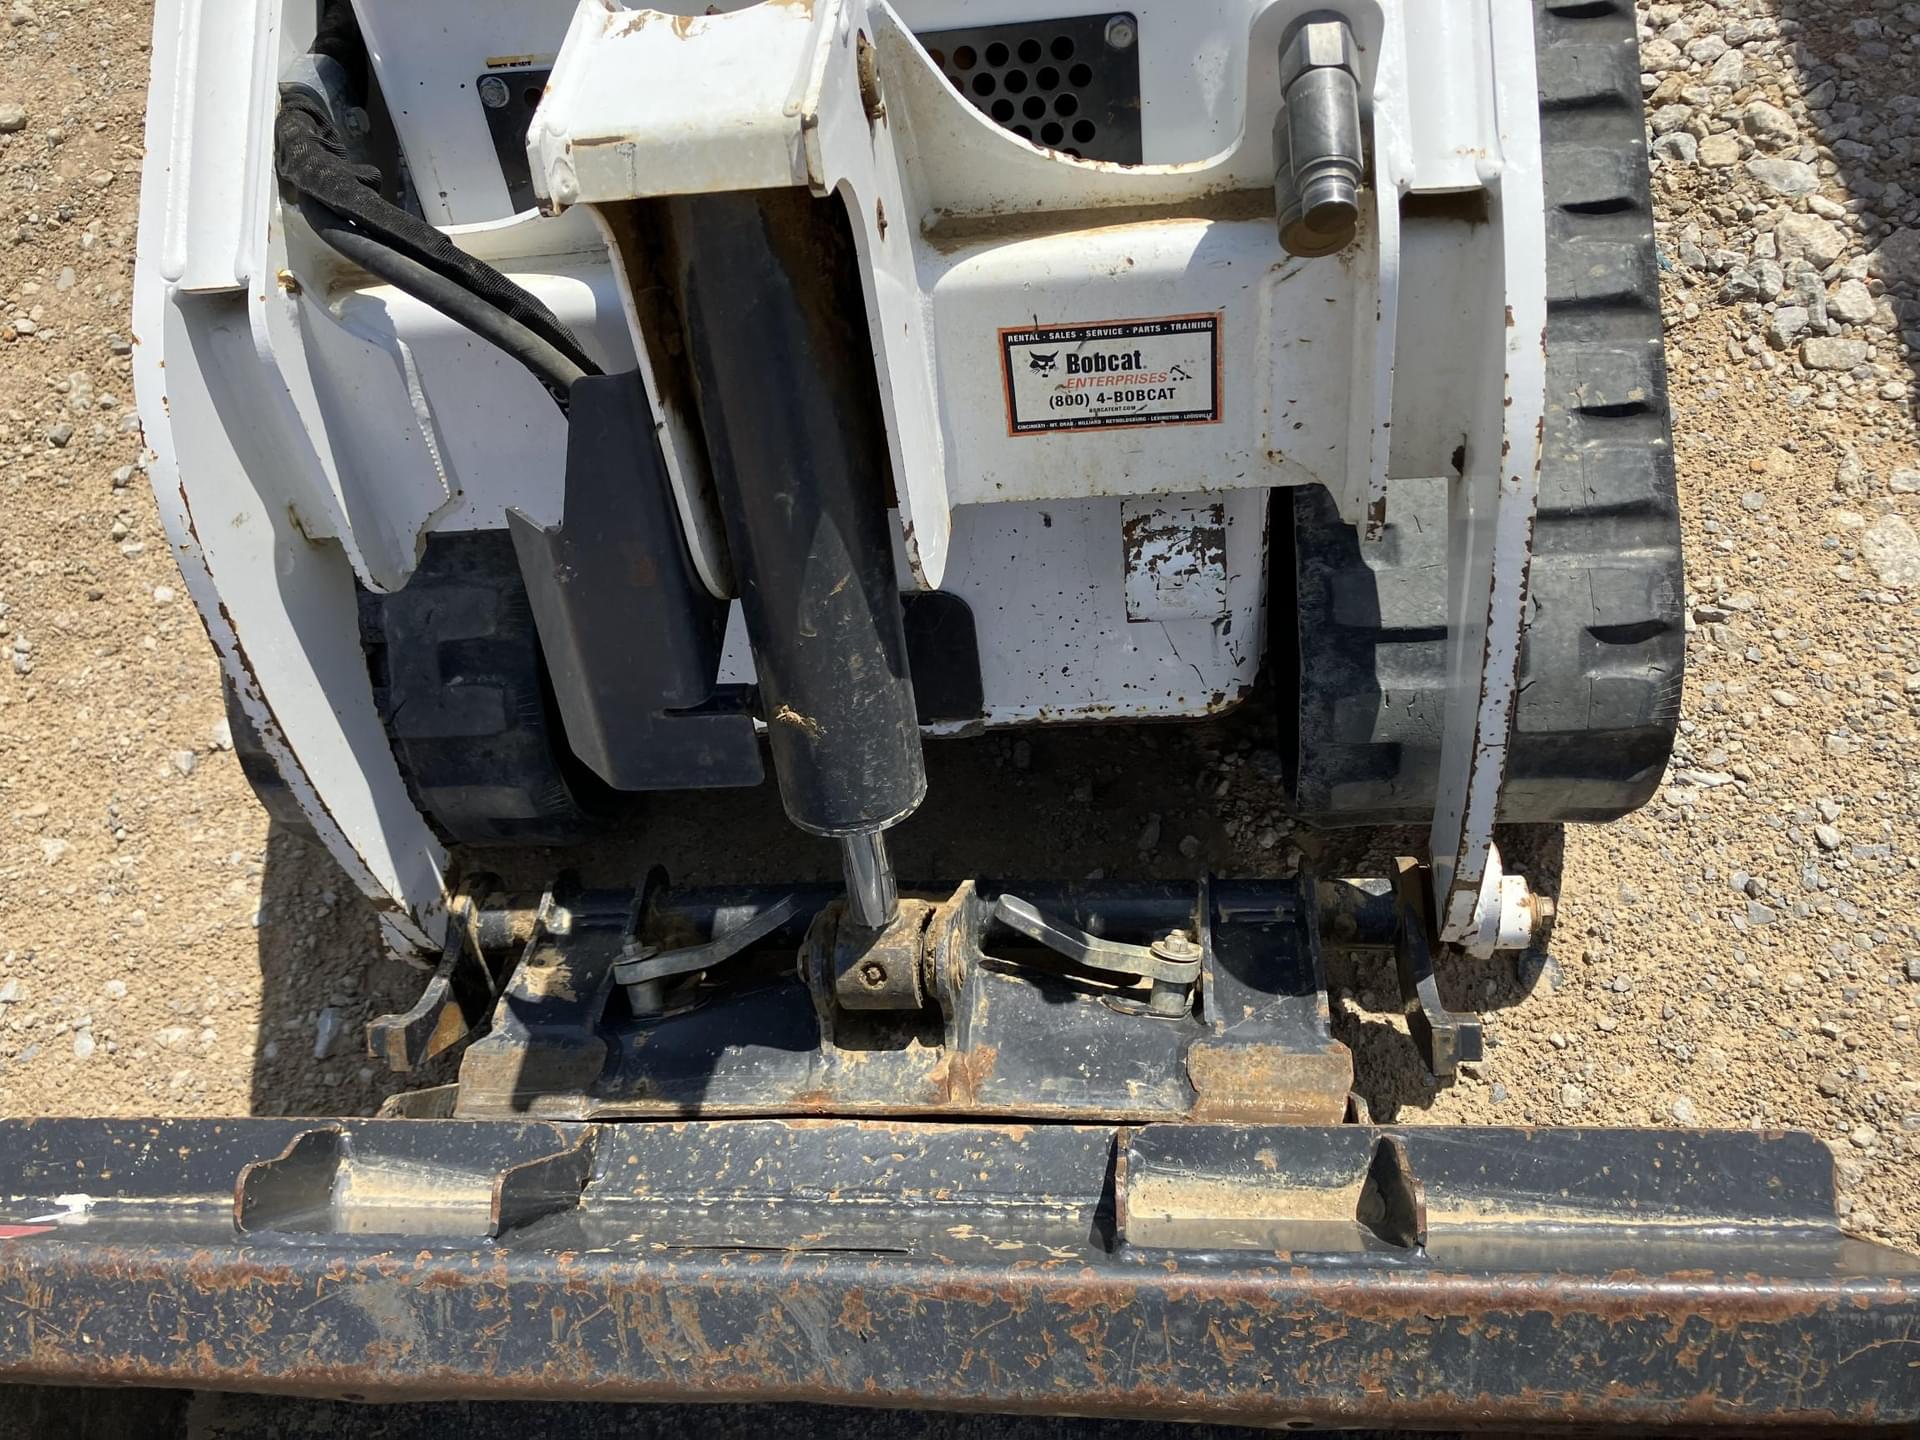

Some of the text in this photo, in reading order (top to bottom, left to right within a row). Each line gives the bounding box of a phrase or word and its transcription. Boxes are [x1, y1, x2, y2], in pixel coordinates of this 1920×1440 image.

[1008, 320, 1213, 342] RENTAL SALES SERVICE PARTS TRAINING
[1066, 350, 1142, 375] Bobcat
[1066, 372, 1168, 389] ENTERPRISES
[1049, 387, 1176, 410] (800) 4-BOBCAT
